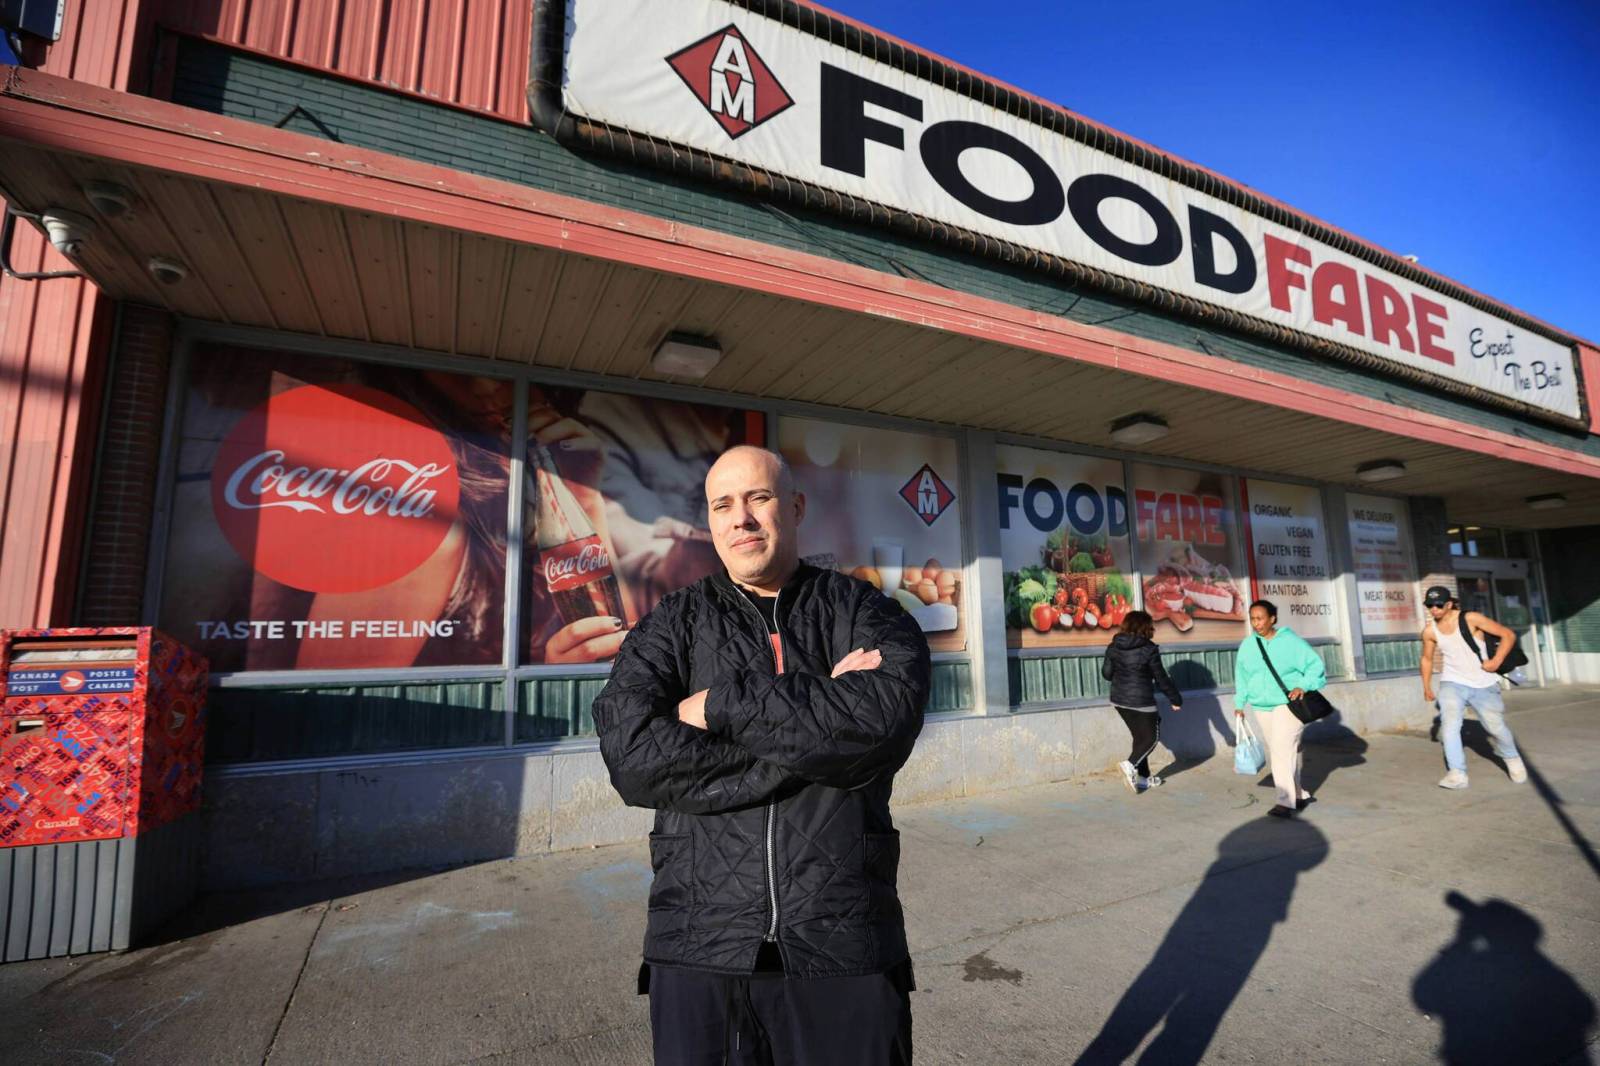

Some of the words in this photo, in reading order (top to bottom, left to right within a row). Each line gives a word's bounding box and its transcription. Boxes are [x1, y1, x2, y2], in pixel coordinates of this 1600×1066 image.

[820, 61, 1257, 295] FOOD
[1264, 233, 1455, 366] FARE
[1469, 327, 1514, 371] Expect
[1504, 362, 1531, 392] The
[1530, 360, 1562, 390] Best
[223, 449, 451, 518] Coca-Cola
[996, 472, 1129, 538] FOOD
[1134, 487, 1227, 545] FARE
[1254, 503, 1293, 518] ORGANIC
[1285, 526, 1314, 539] VEGAN
[1258, 543, 1291, 557] GLUTEN
[1292, 545, 1312, 558] FREE
[544, 543, 609, 585] Coca-Cola
[1273, 564, 1289, 576] ALL
[1289, 565, 1326, 577] NATURAL
[1262, 584, 1309, 597] MANITOBA
[1364, 590, 1383, 601] MEAT
[1384, 591, 1406, 602] PACKS
[1290, 603, 1332, 616] PRODUCTS
[197, 620, 285, 640] TASTE
[291, 620, 344, 639] THE
[12, 672, 57, 680] CANADA
[89, 670, 127, 678] POSTES
[87, 682, 131, 690] CANADA
